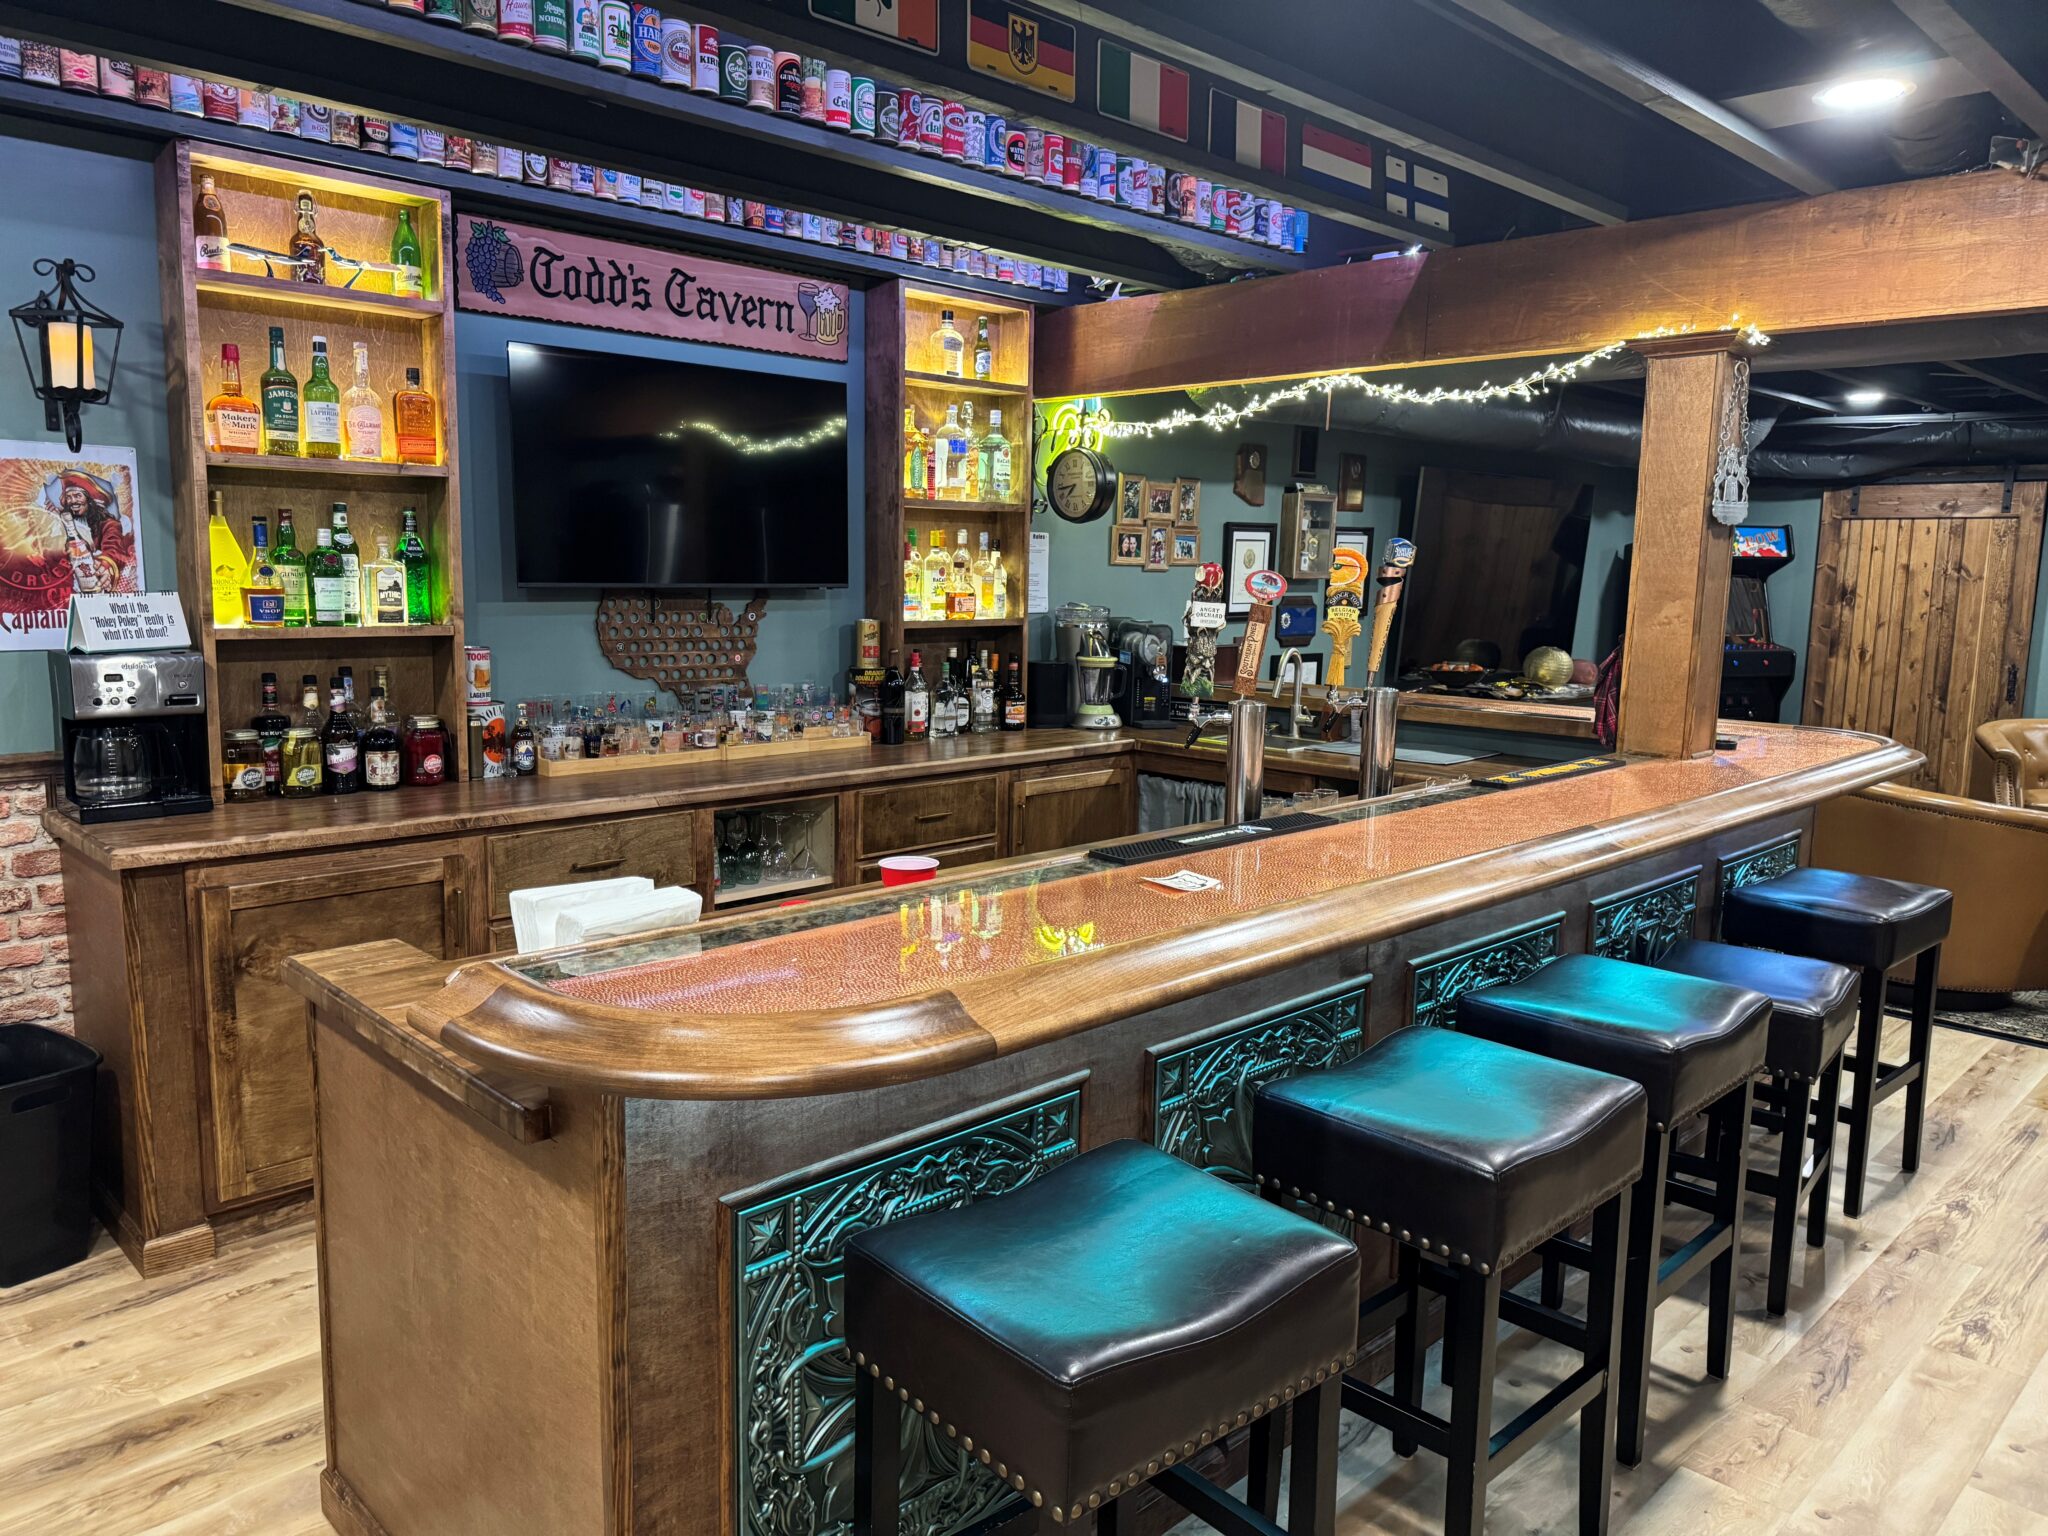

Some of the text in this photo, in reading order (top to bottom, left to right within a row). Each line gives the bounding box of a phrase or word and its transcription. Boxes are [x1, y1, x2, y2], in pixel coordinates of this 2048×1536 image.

[529, 246, 795, 334] Todd's Tavern
[222, 413, 257, 422] Maker's
[232, 421, 257, 430] Mark
[1330, 592, 1360, 607] SHOCK TOP
[109, 602, 149, 614] What if the
[144, 613, 164, 625] really
[167, 613, 175, 624] is
[102, 626, 169, 640] what it's all about?
